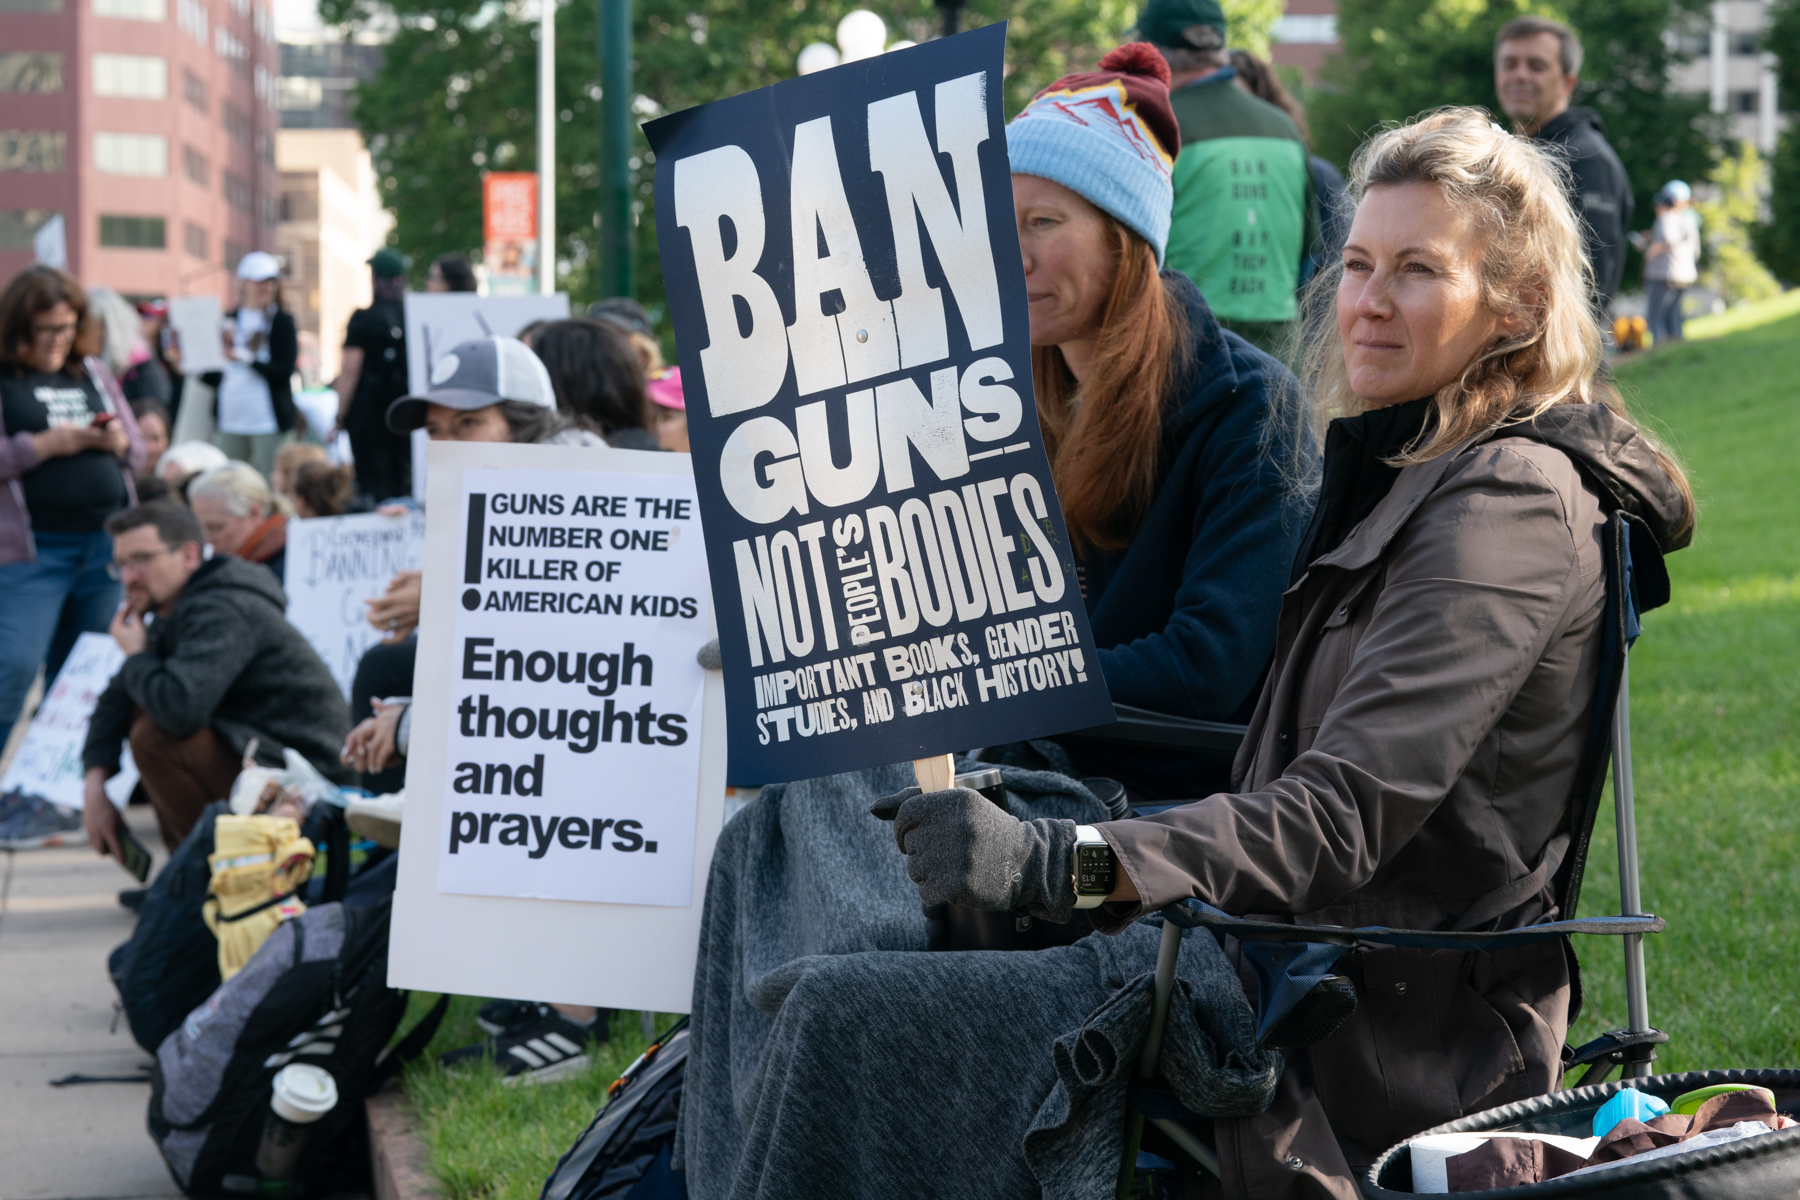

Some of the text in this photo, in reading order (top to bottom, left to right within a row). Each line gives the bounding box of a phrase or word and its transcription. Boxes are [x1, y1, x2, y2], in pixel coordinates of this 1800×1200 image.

[674, 70, 1004, 418] BAN
[720, 356, 1023, 524] GUNS
[490, 493, 691, 520] GUNS ARE THE
[488, 526, 669, 552] NUMBER ONE
[486, 558, 621, 582] KILLER OF
[733, 473, 1066, 667] NOT PEOPLE'S BODIES
[484, 591, 698, 619] AMERICAN KIDS
[462, 637, 654, 697] Enough
[754, 611, 1080, 710] IMPORTANT BOOKS, GENDER
[457, 694, 688, 754] thoughts
[756, 648, 1088, 746] STUDIES, AND BLACK HISTORY!
[453, 754, 545, 797] and
[449, 811, 659, 859] prayers.
